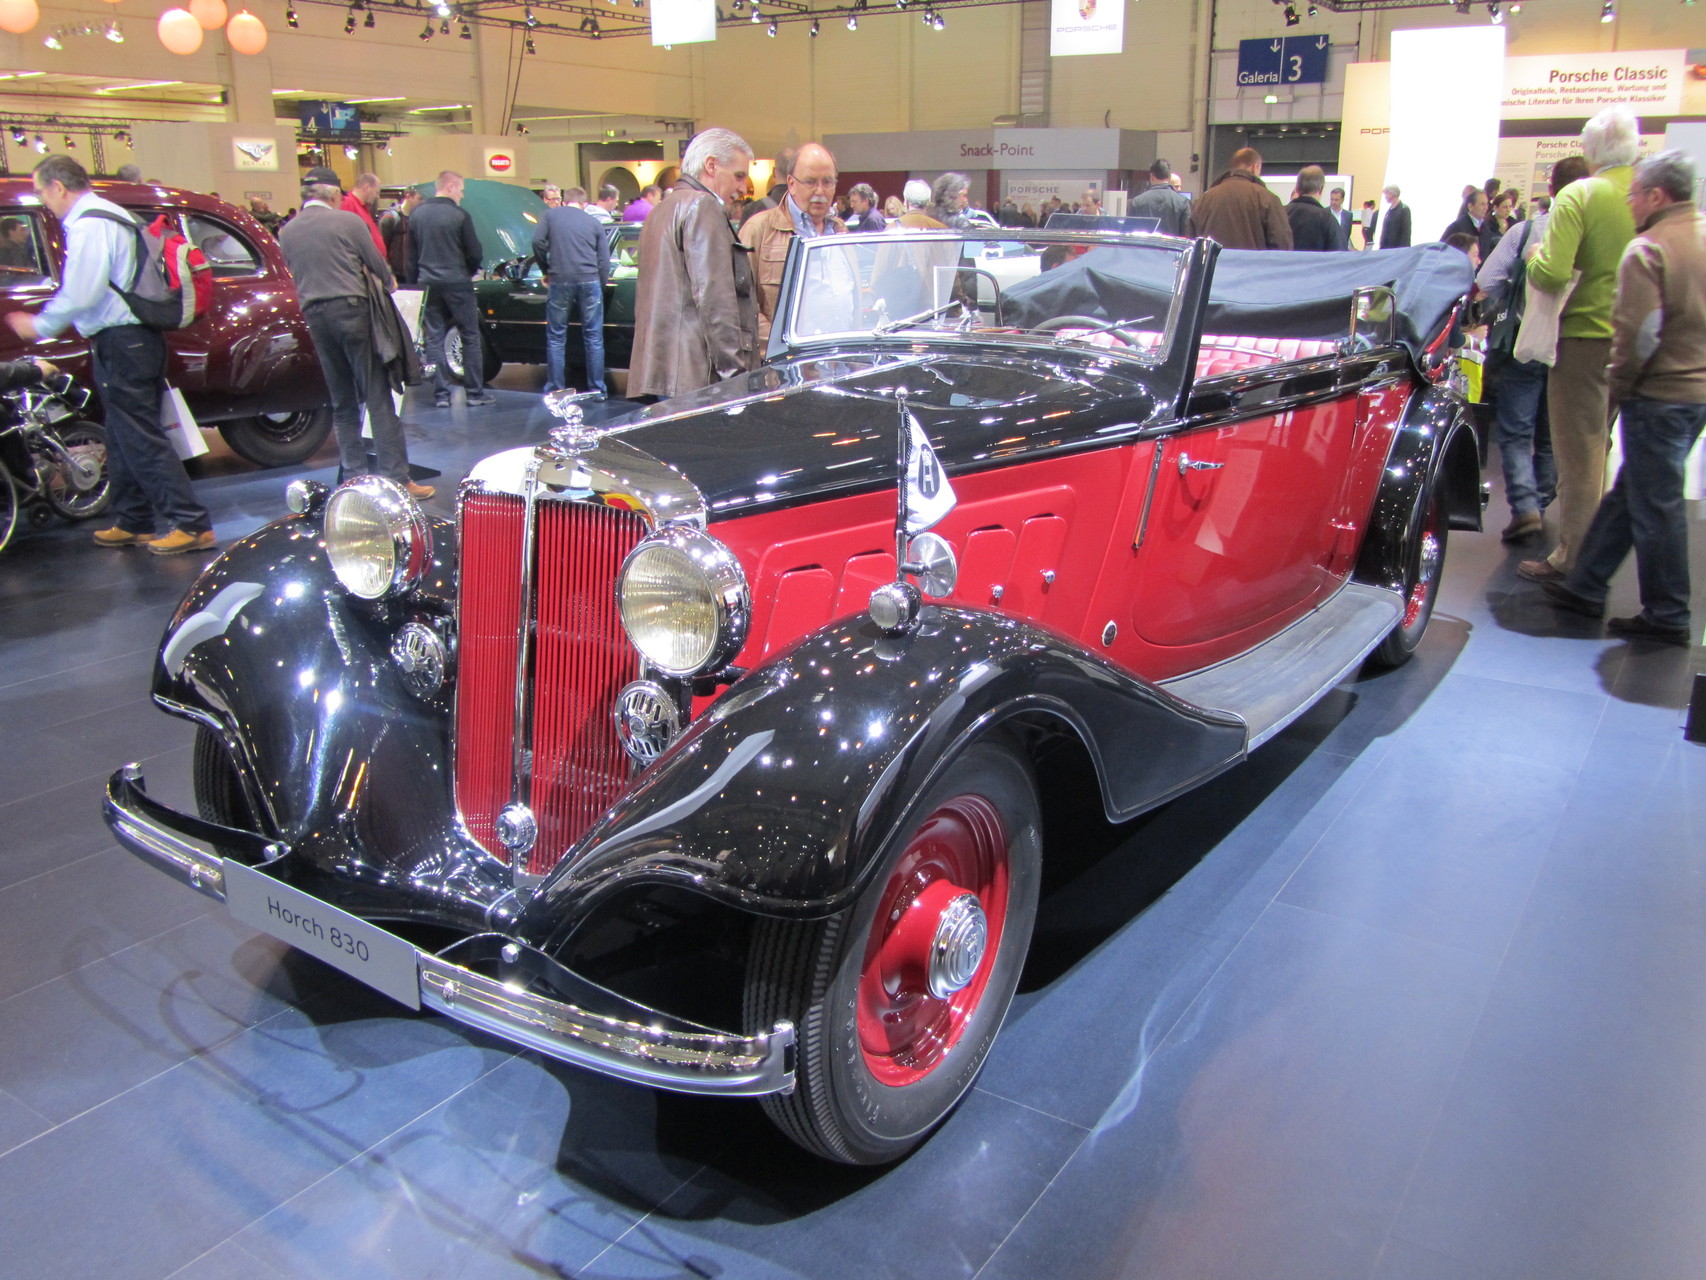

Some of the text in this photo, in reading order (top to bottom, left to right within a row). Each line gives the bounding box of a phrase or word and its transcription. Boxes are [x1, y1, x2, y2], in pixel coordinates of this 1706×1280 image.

[1056, 24, 1118, 33] PORSCHE
[1288, 55, 1303, 82] 3
[1549, 65, 1668, 83] Porsche Classic
[1238, 71, 1279, 84] Galeria
[1511, 83, 1667, 96] Originalteile, Restaurierung, Wartung und
[1528, 98, 1560, 106] Literatur
[1562, 97, 1573, 105] für
[1575, 96, 1594, 104] Ihren
[1596, 95, 1627, 104] Porsche
[1629, 94, 1666, 103] Klassiker
[1360, 127, 1390, 135] POR
[960, 142, 1035, 157] Snack-Point
[1536, 141, 1568, 149] Porsche
[1535, 150, 1567, 159] Porsche
[1010, 186, 1060, 194] PORSCHE
[267, 896, 369, 962] Horch 830
